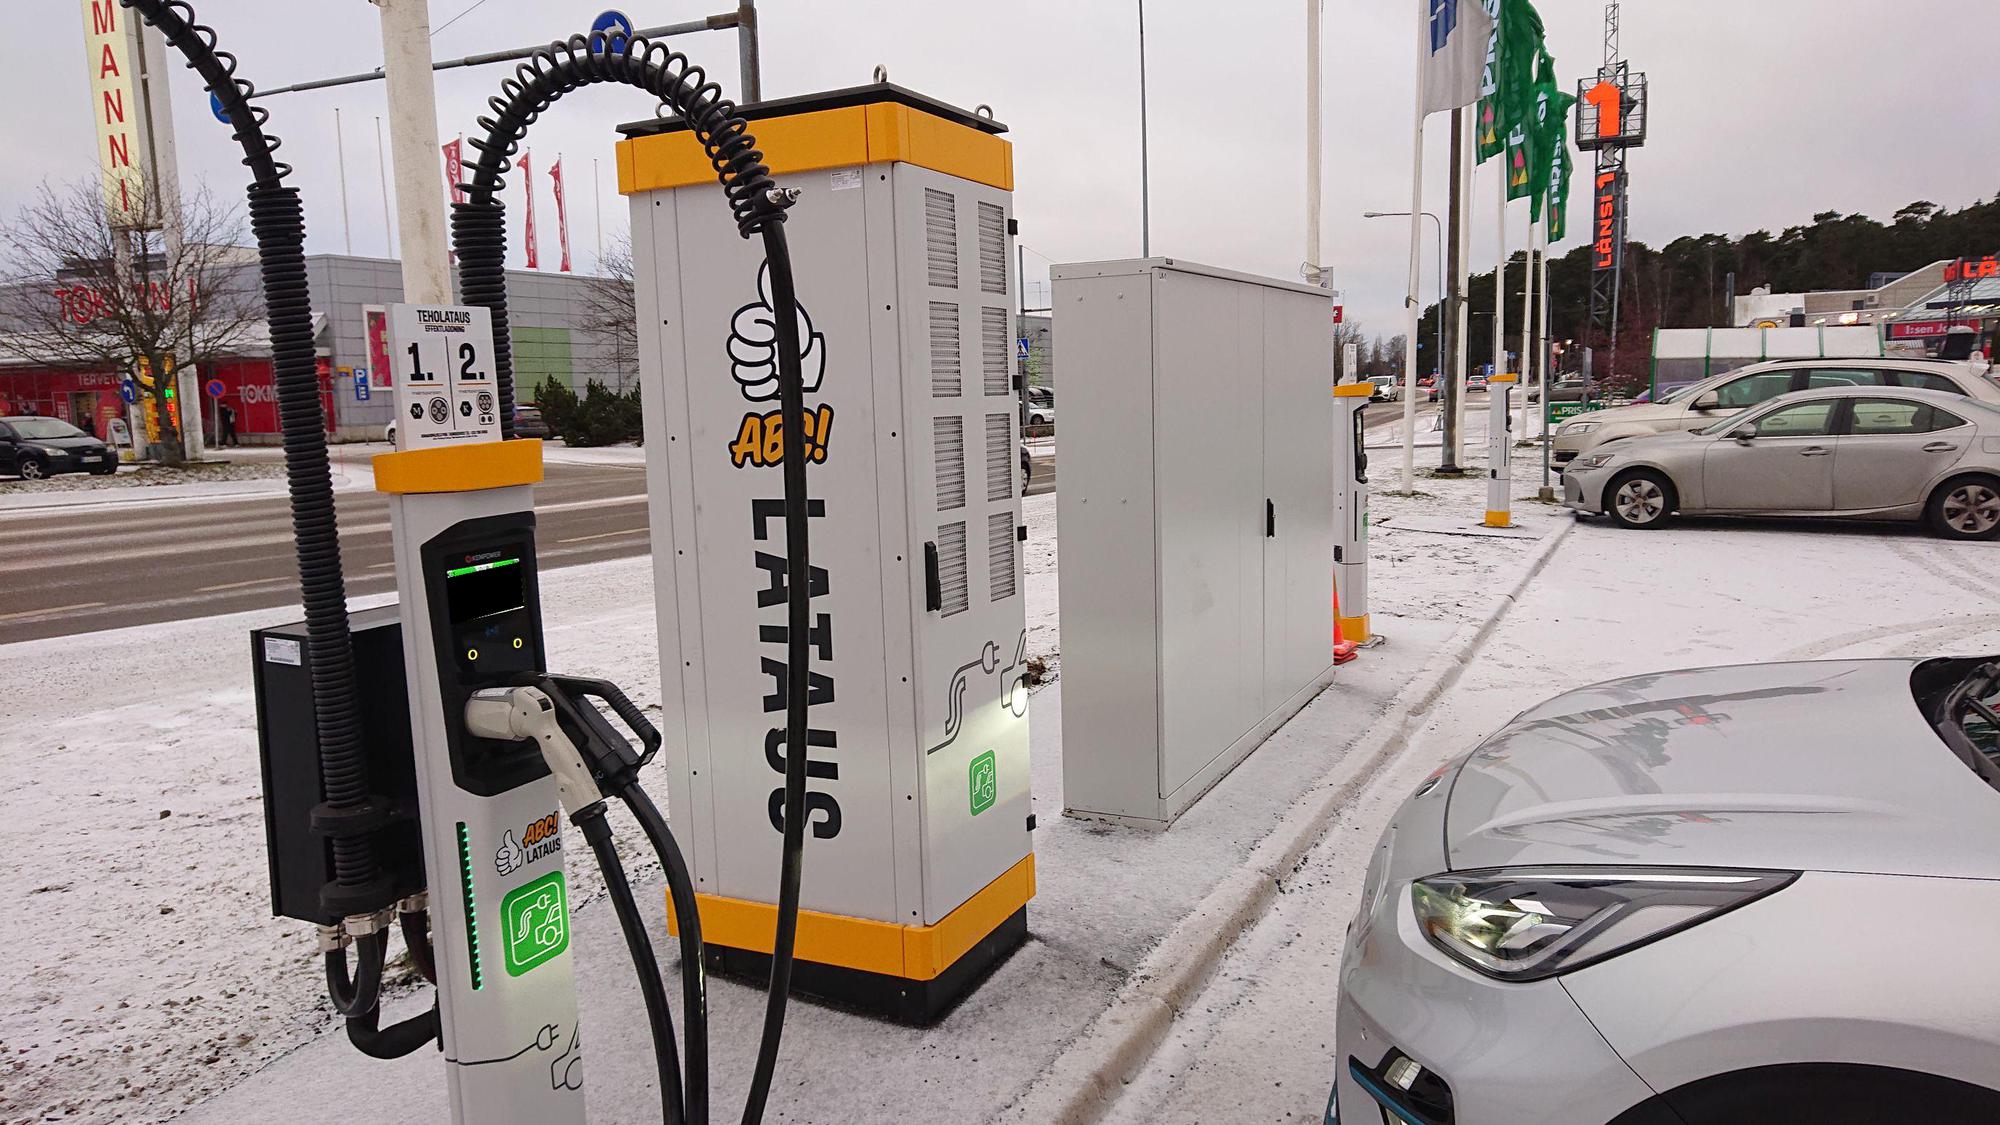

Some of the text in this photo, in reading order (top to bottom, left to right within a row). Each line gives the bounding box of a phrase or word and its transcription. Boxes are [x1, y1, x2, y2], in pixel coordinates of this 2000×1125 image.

[1584, 79, 1621, 137] 1
[1596, 171, 1615, 267] LÄNSI 1
[416, 309, 471, 323] TEHOLATAUS
[407, 342, 434, 381] 1.
[458, 342, 485, 380] 2.
[751, 498, 843, 840] LATAUS
[521, 810, 559, 849] ABC!
[526, 837, 561, 864] LATAUS
